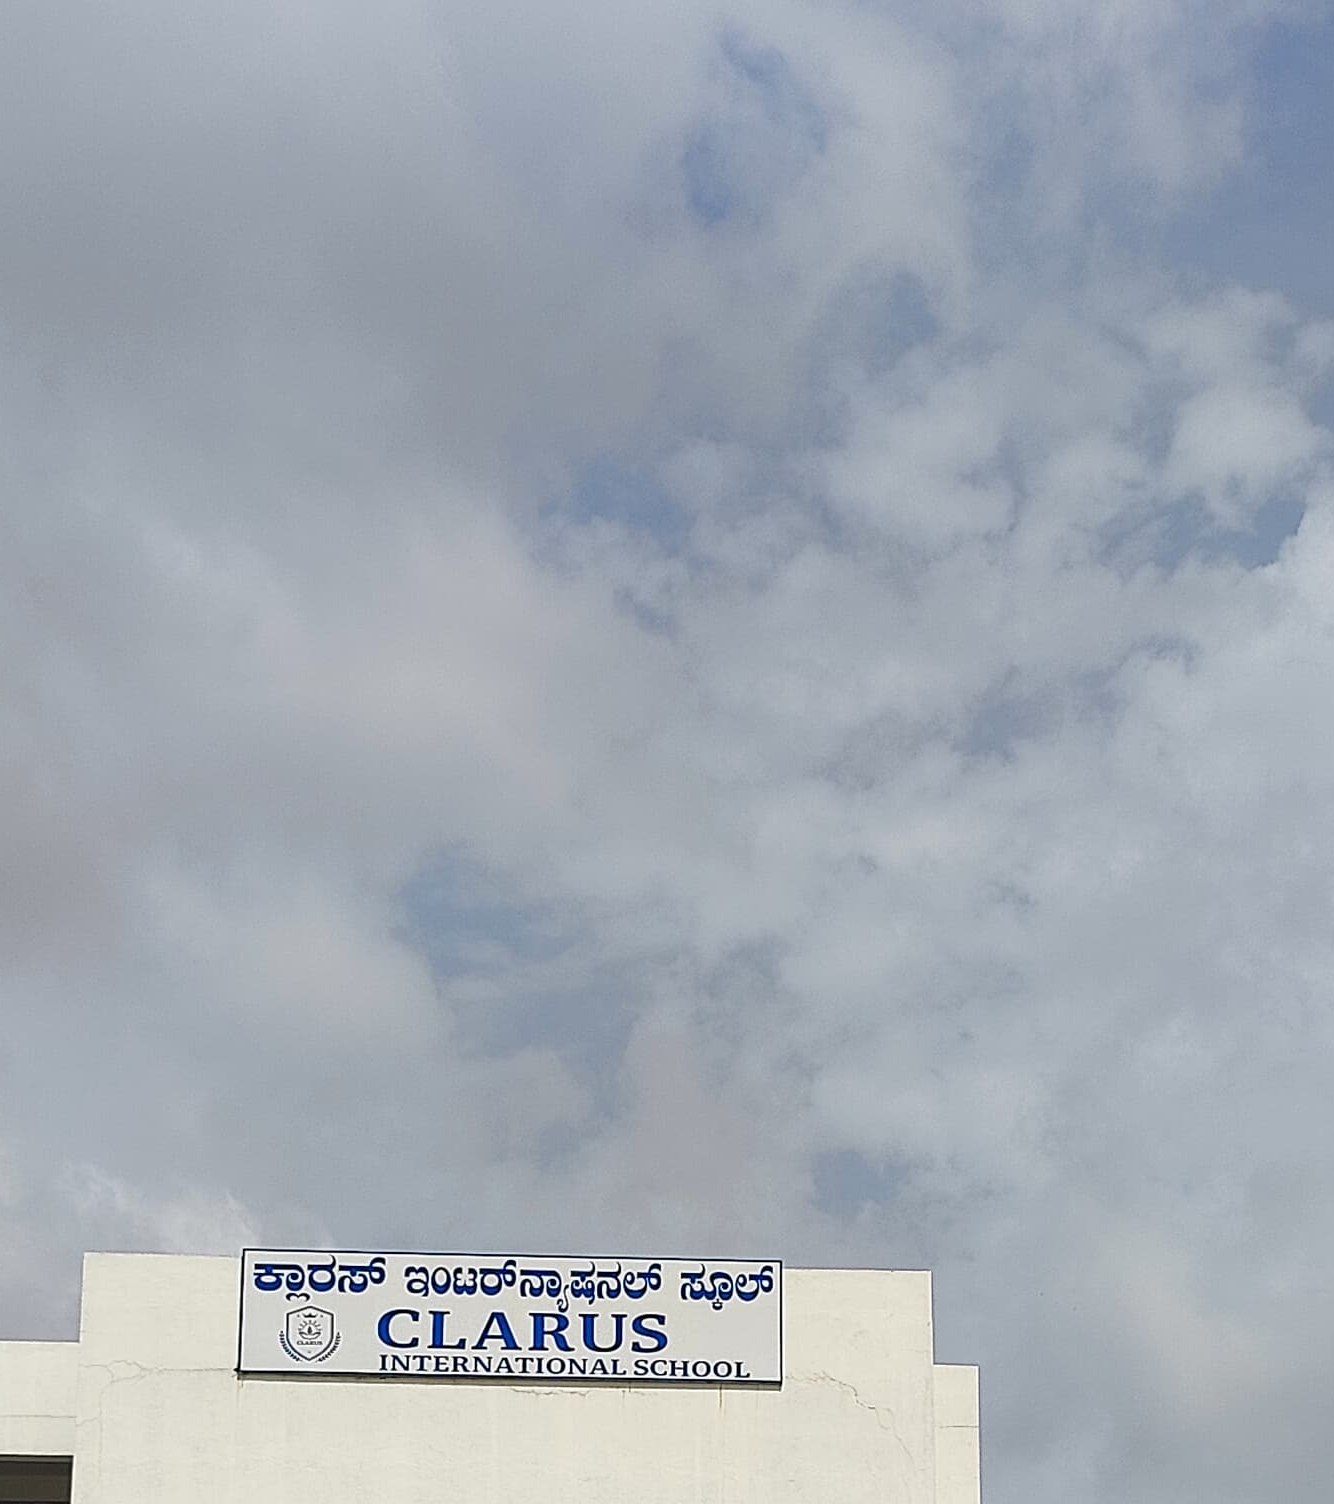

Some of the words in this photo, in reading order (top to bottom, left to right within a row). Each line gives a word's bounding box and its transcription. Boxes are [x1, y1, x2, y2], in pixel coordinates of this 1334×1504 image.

[253, 1254, 387, 1302] ಕ್ಲಾರಸ್
[377, 1308, 668, 1354] CLARUS
[378, 1353, 627, 1377] INTERNATIONAL
[633, 1358, 751, 1379] SCHOOL
